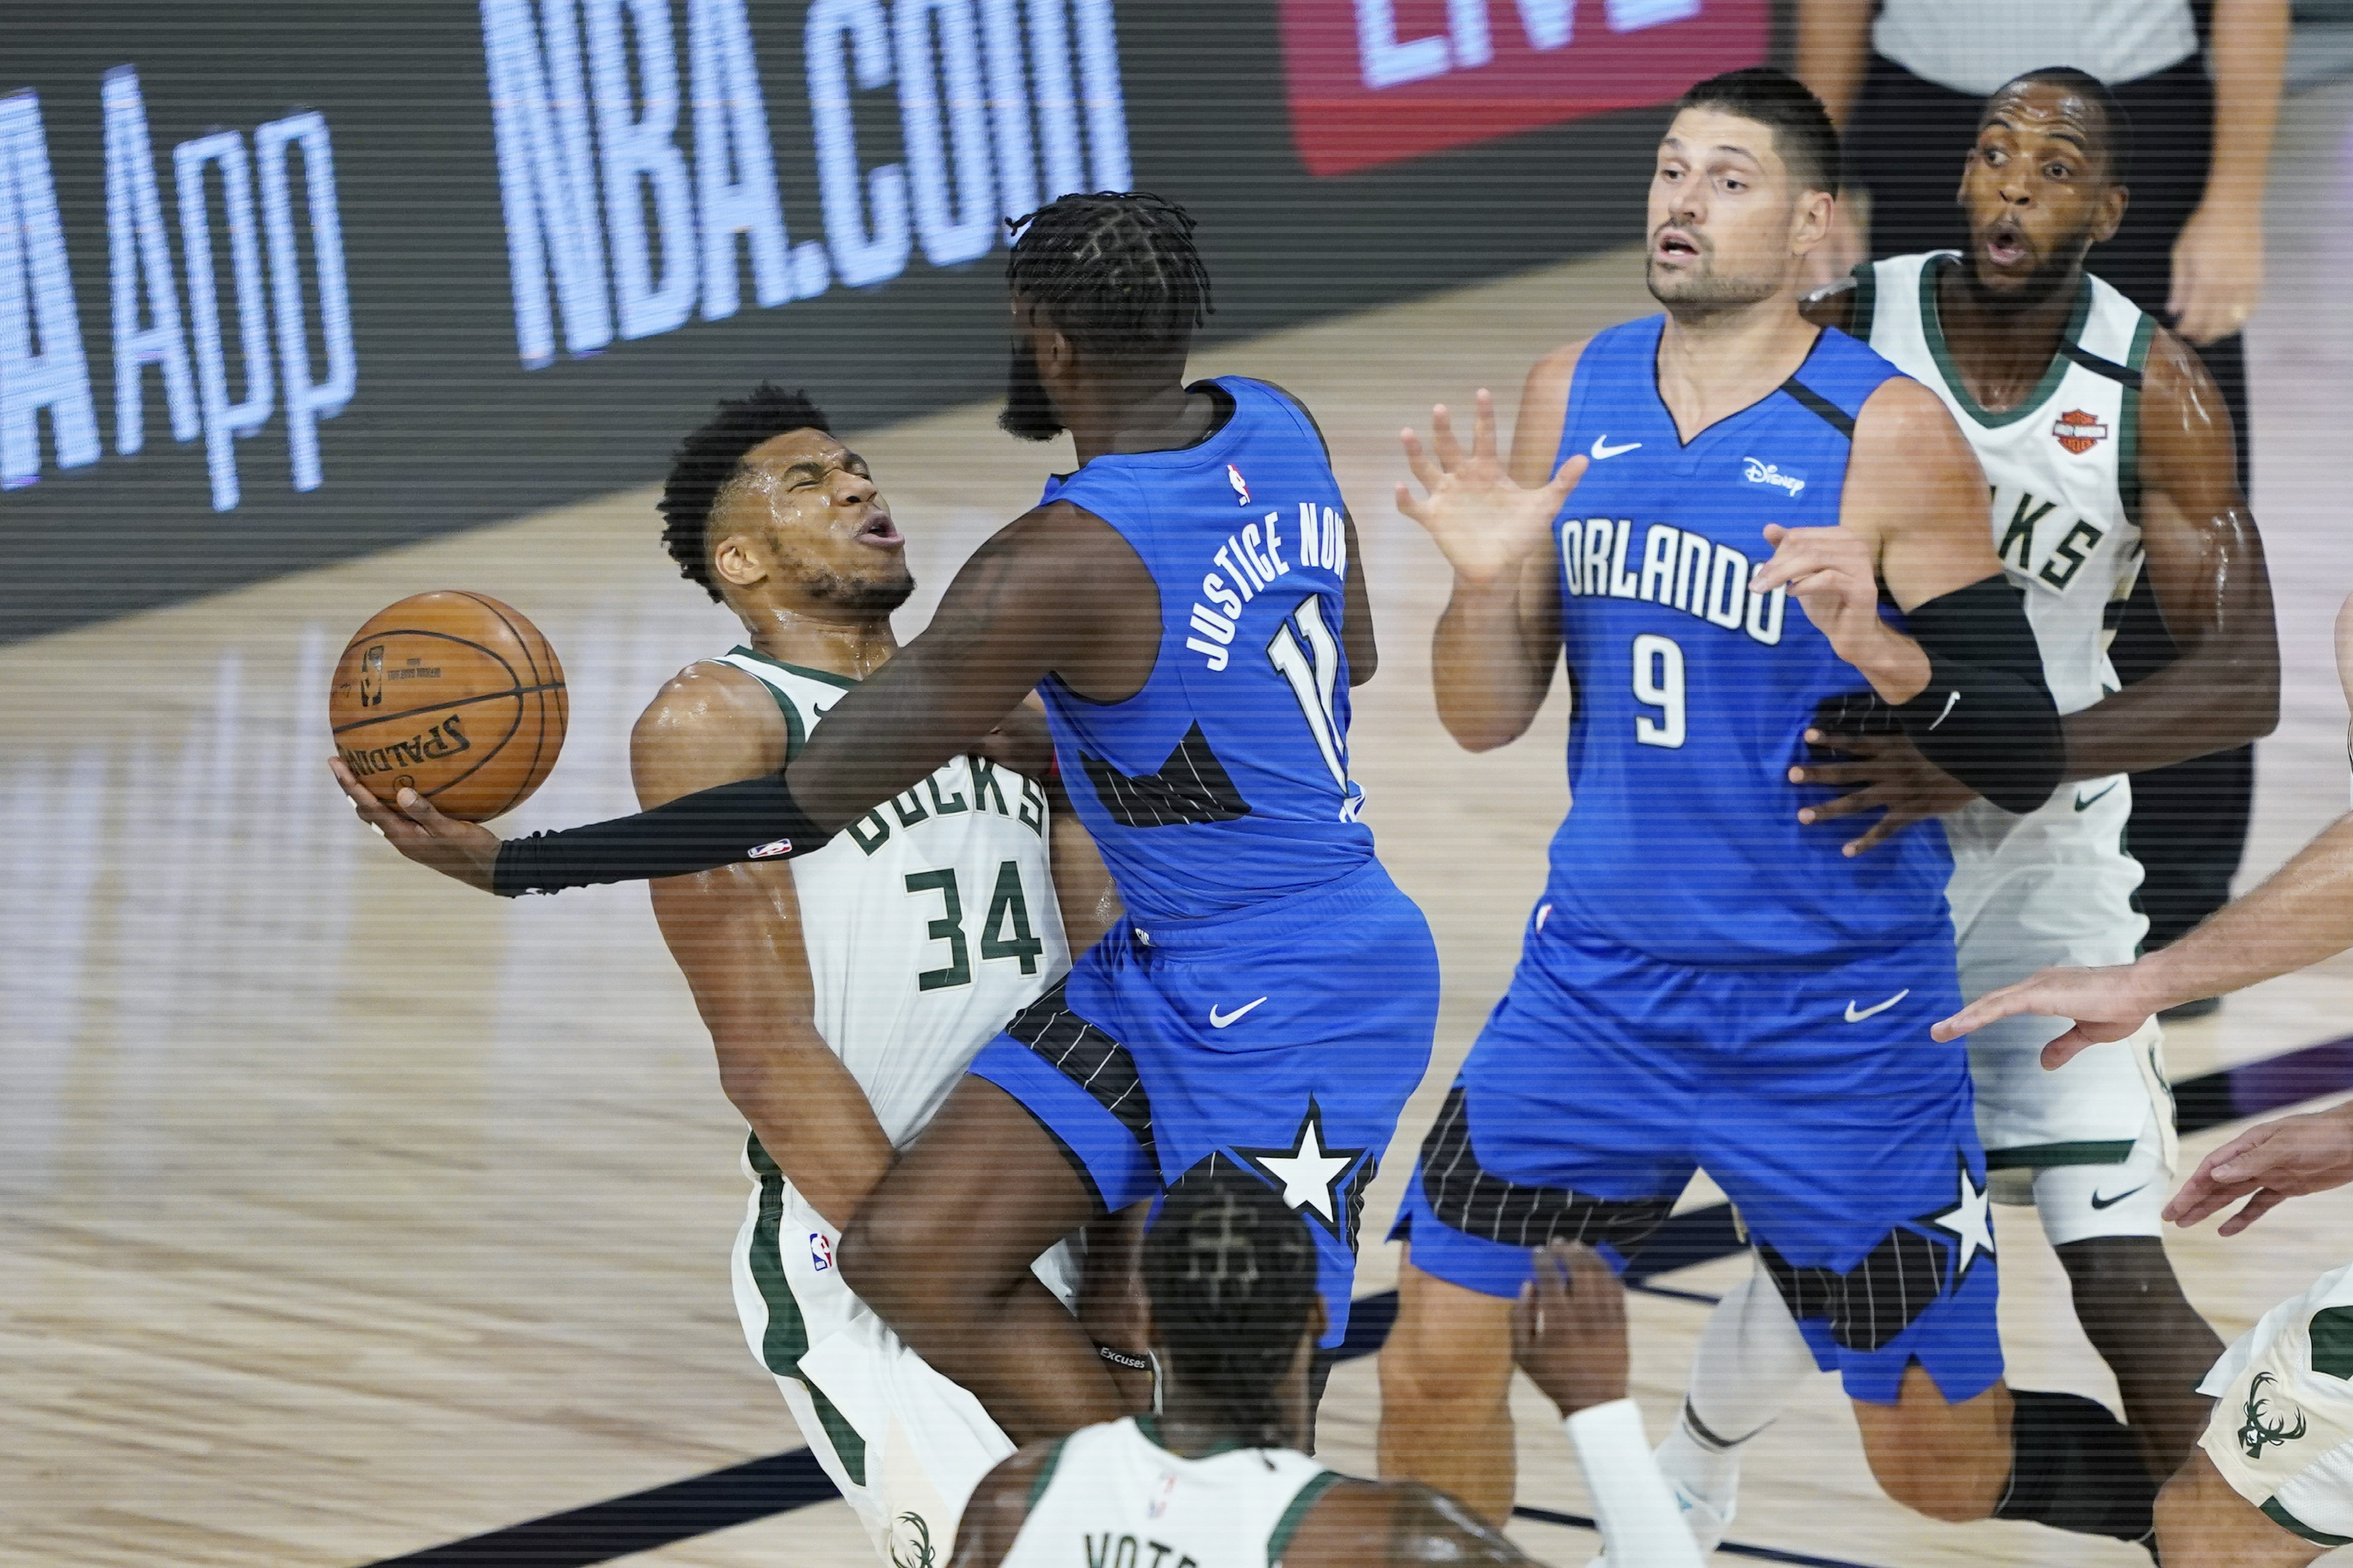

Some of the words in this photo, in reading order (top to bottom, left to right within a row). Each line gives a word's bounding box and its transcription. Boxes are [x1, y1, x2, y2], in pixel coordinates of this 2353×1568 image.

[1352, 0, 1705, 91] LI
[101, 64, 357, 512] App
[1186, 512, 1290, 672] JUSTICE
[1561, 518, 1788, 646] ORLANDO
[336, 714, 470, 777] SPALDIN
[1266, 593, 1349, 796] 11
[1632, 633, 1687, 749] 9
[903, 859, 1043, 993] 34
[1100, 1346, 1145, 1369] Excuses
[1084, 1532, 1198, 1568] VOT
